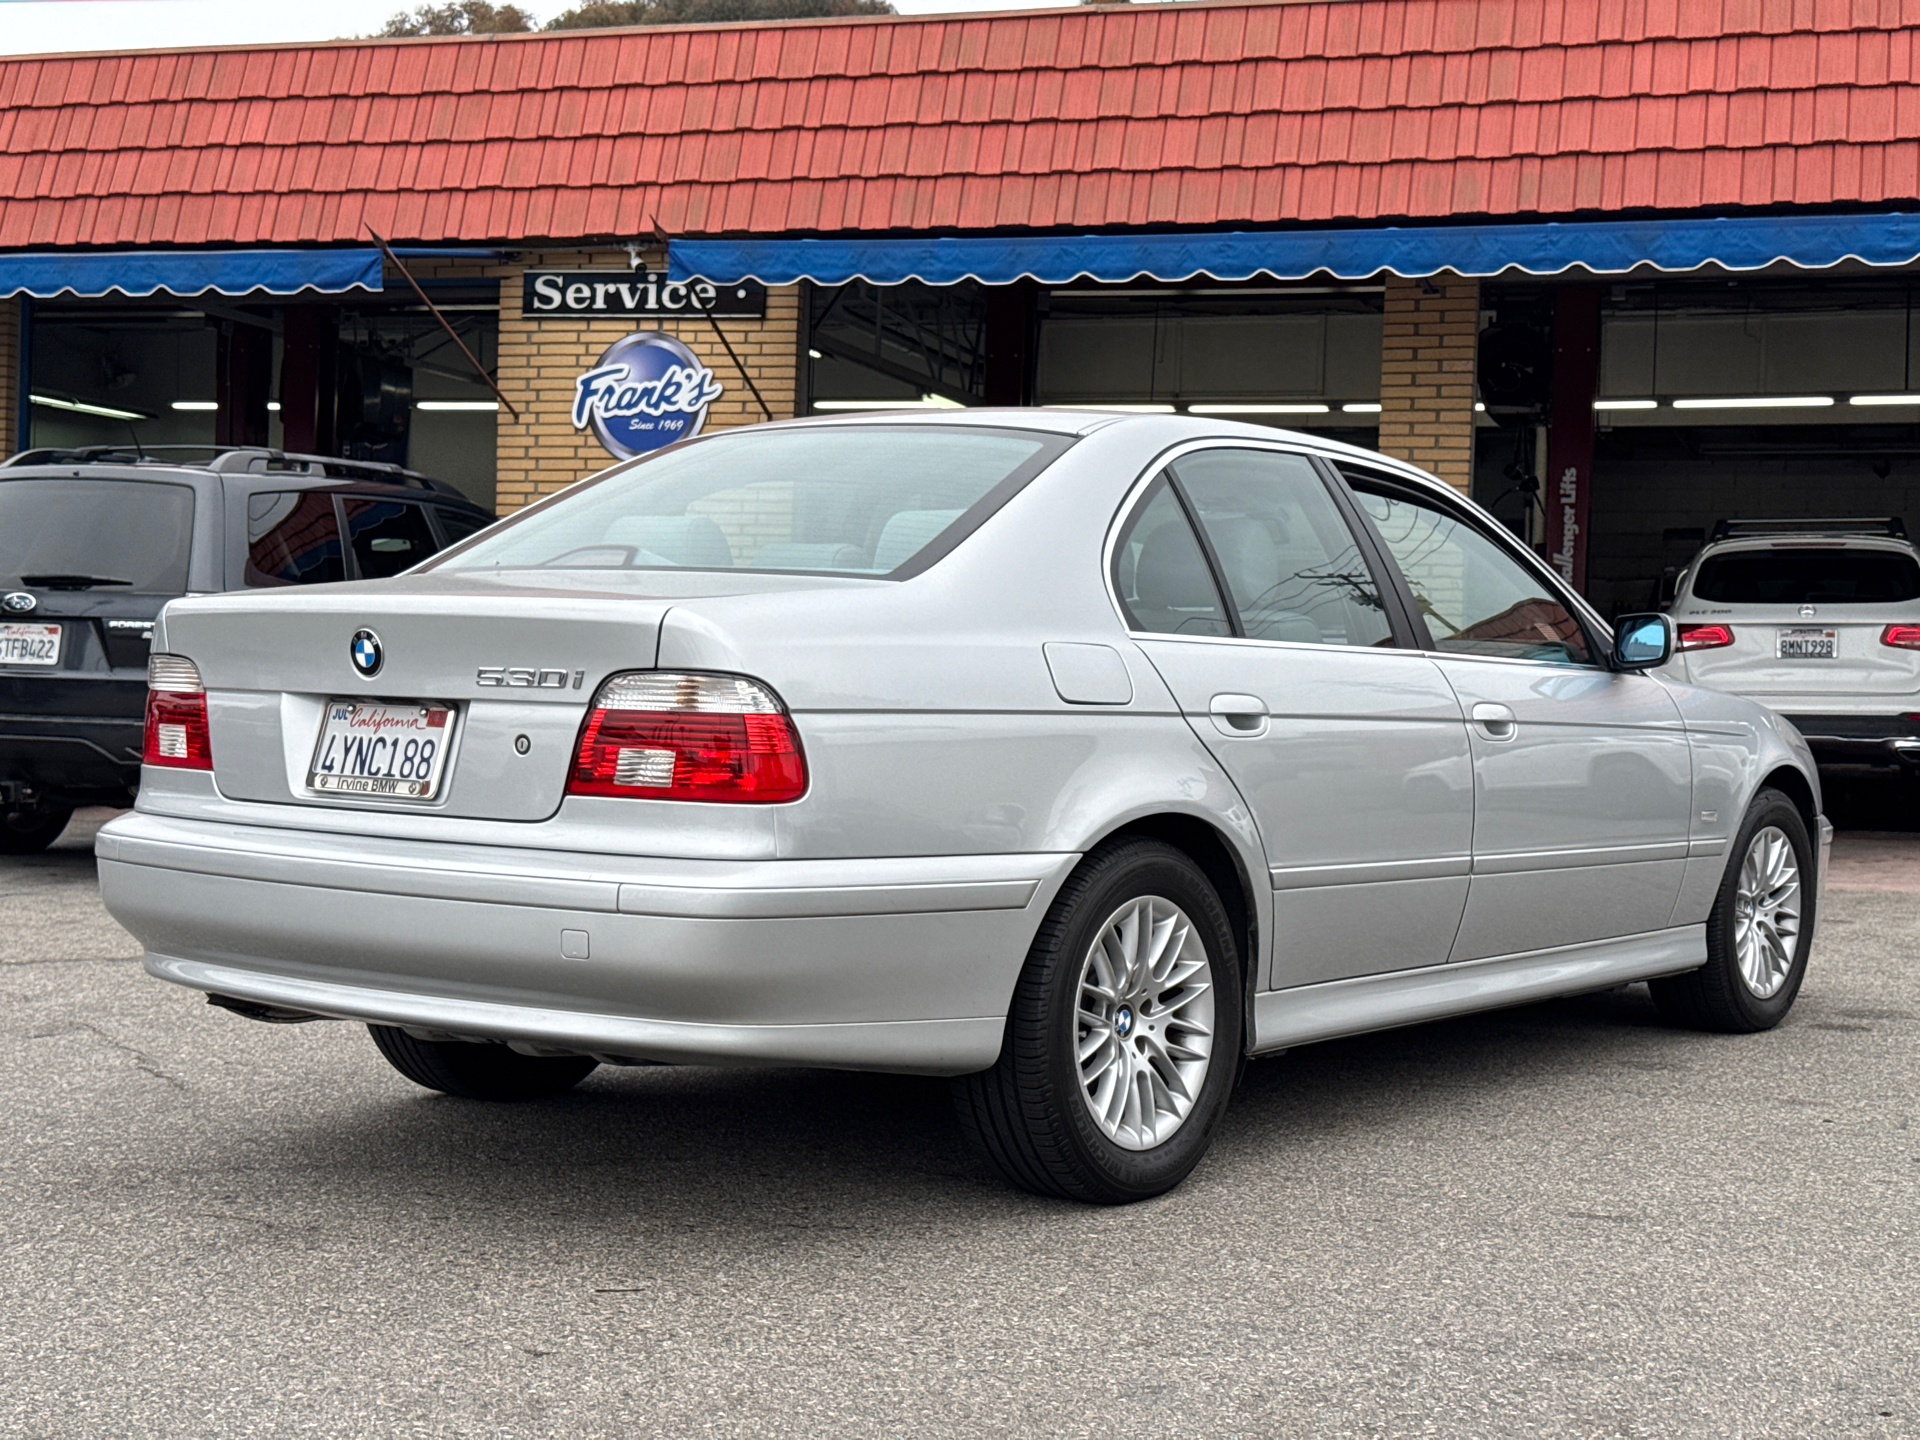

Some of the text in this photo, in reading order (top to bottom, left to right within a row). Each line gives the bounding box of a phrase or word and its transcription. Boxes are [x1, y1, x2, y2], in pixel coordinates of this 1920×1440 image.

[533, 274, 717, 310] Service
[572, 363, 723, 429] Frank's
[629, 418, 684, 432] Since 1969
[1552, 467, 1579, 587] allenger Lifts
[0, 638, 55, 660] TFB422
[1780, 639, 1833, 655] 8MNT998
[476, 666, 585, 690] 530i
[332, 708, 349, 721] JUL
[349, 707, 426, 735] California
[320, 734, 436, 780] 4YNC188
[336, 776, 399, 793] Irvine BMW
[1067, 1097, 1124, 1178] MICHELIN
